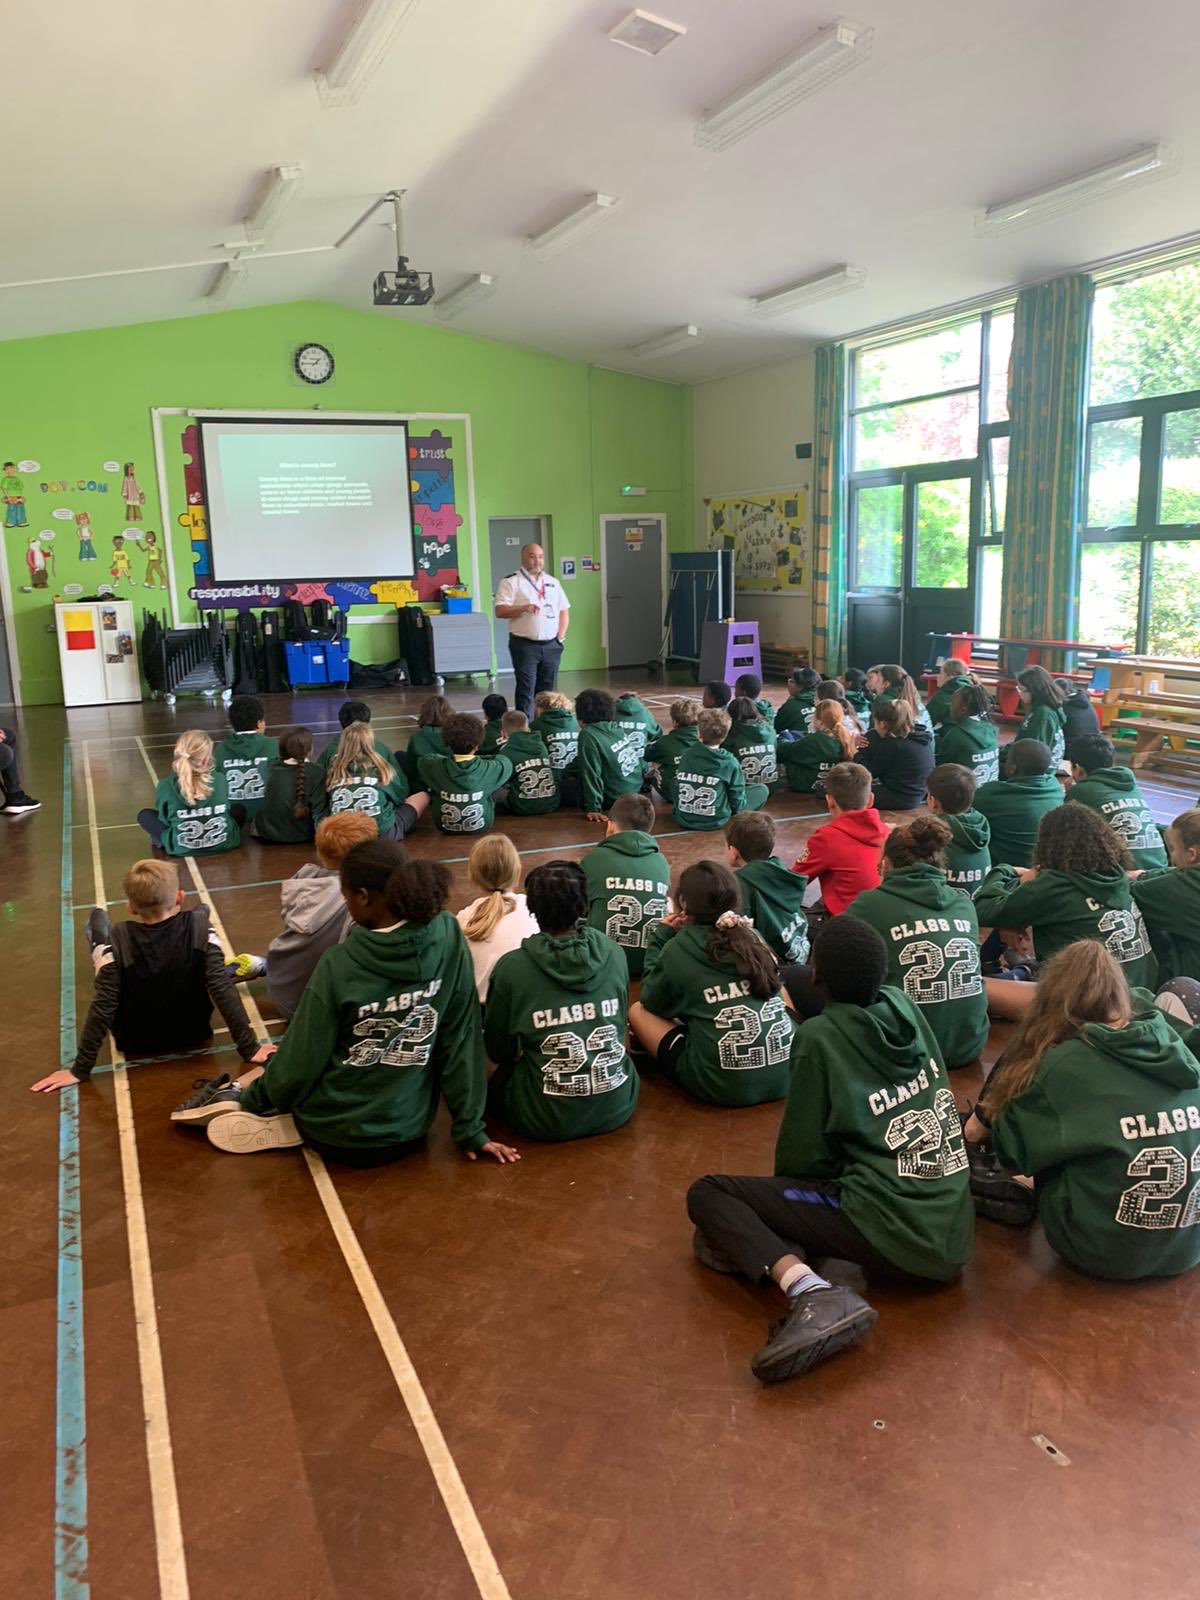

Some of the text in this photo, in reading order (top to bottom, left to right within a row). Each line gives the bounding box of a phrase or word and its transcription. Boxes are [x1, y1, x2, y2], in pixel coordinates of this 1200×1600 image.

[419, 447, 445, 459] trust
[423, 541, 451, 558] hope
[566, 561, 574, 576] P
[738, 746, 766, 756] CLASS
[226, 768, 266, 800] 22
[518, 767, 557, 799] 22
[676, 771, 720, 785] CLASS OF
[741, 755, 778, 784] 22
[177, 806, 213, 819] CLASS
[440, 790, 469, 803] CLASS
[678, 783, 717, 816] 22
[1101, 798, 1140, 814] CLASS
[176, 816, 228, 849] 22
[440, 803, 485, 831] 22
[605, 876, 653, 893] CLASS
[606, 894, 669, 949] 22
[890, 918, 972, 942] CLASS OF
[899, 937, 983, 1004] 22
[532, 998, 620, 1030] CLASS OF
[342, 1003, 439, 1067] 22
[713, 996, 796, 1071] 22
[540, 1023, 629, 1097] 22
[868, 1068, 930, 1117] CLASS
[884, 1088, 970, 1179] 22
[1119, 1105, 1200, 1140] CLASS
